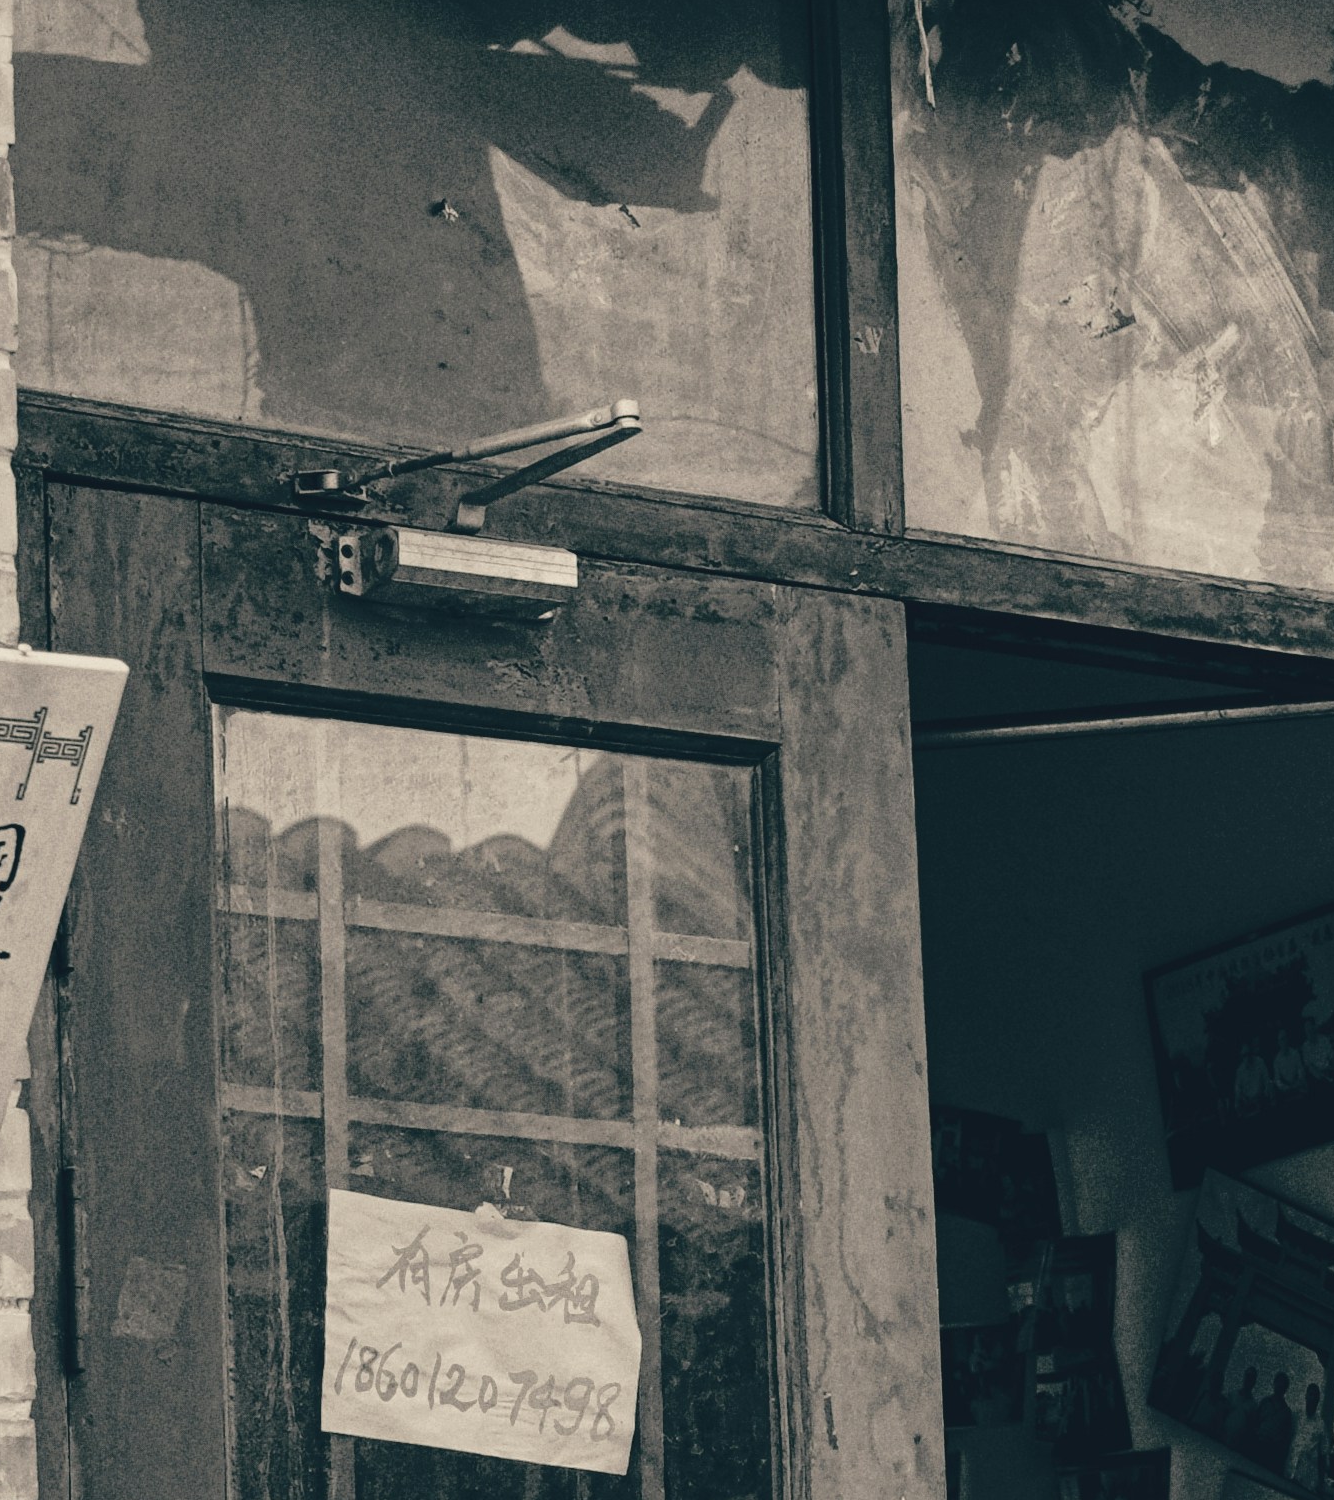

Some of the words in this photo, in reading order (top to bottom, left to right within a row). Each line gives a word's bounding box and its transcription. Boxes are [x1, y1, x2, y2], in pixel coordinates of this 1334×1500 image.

[375, 1224, 602, 1328] 有房出租
[334, 1336, 622, 1442] 18601207498
